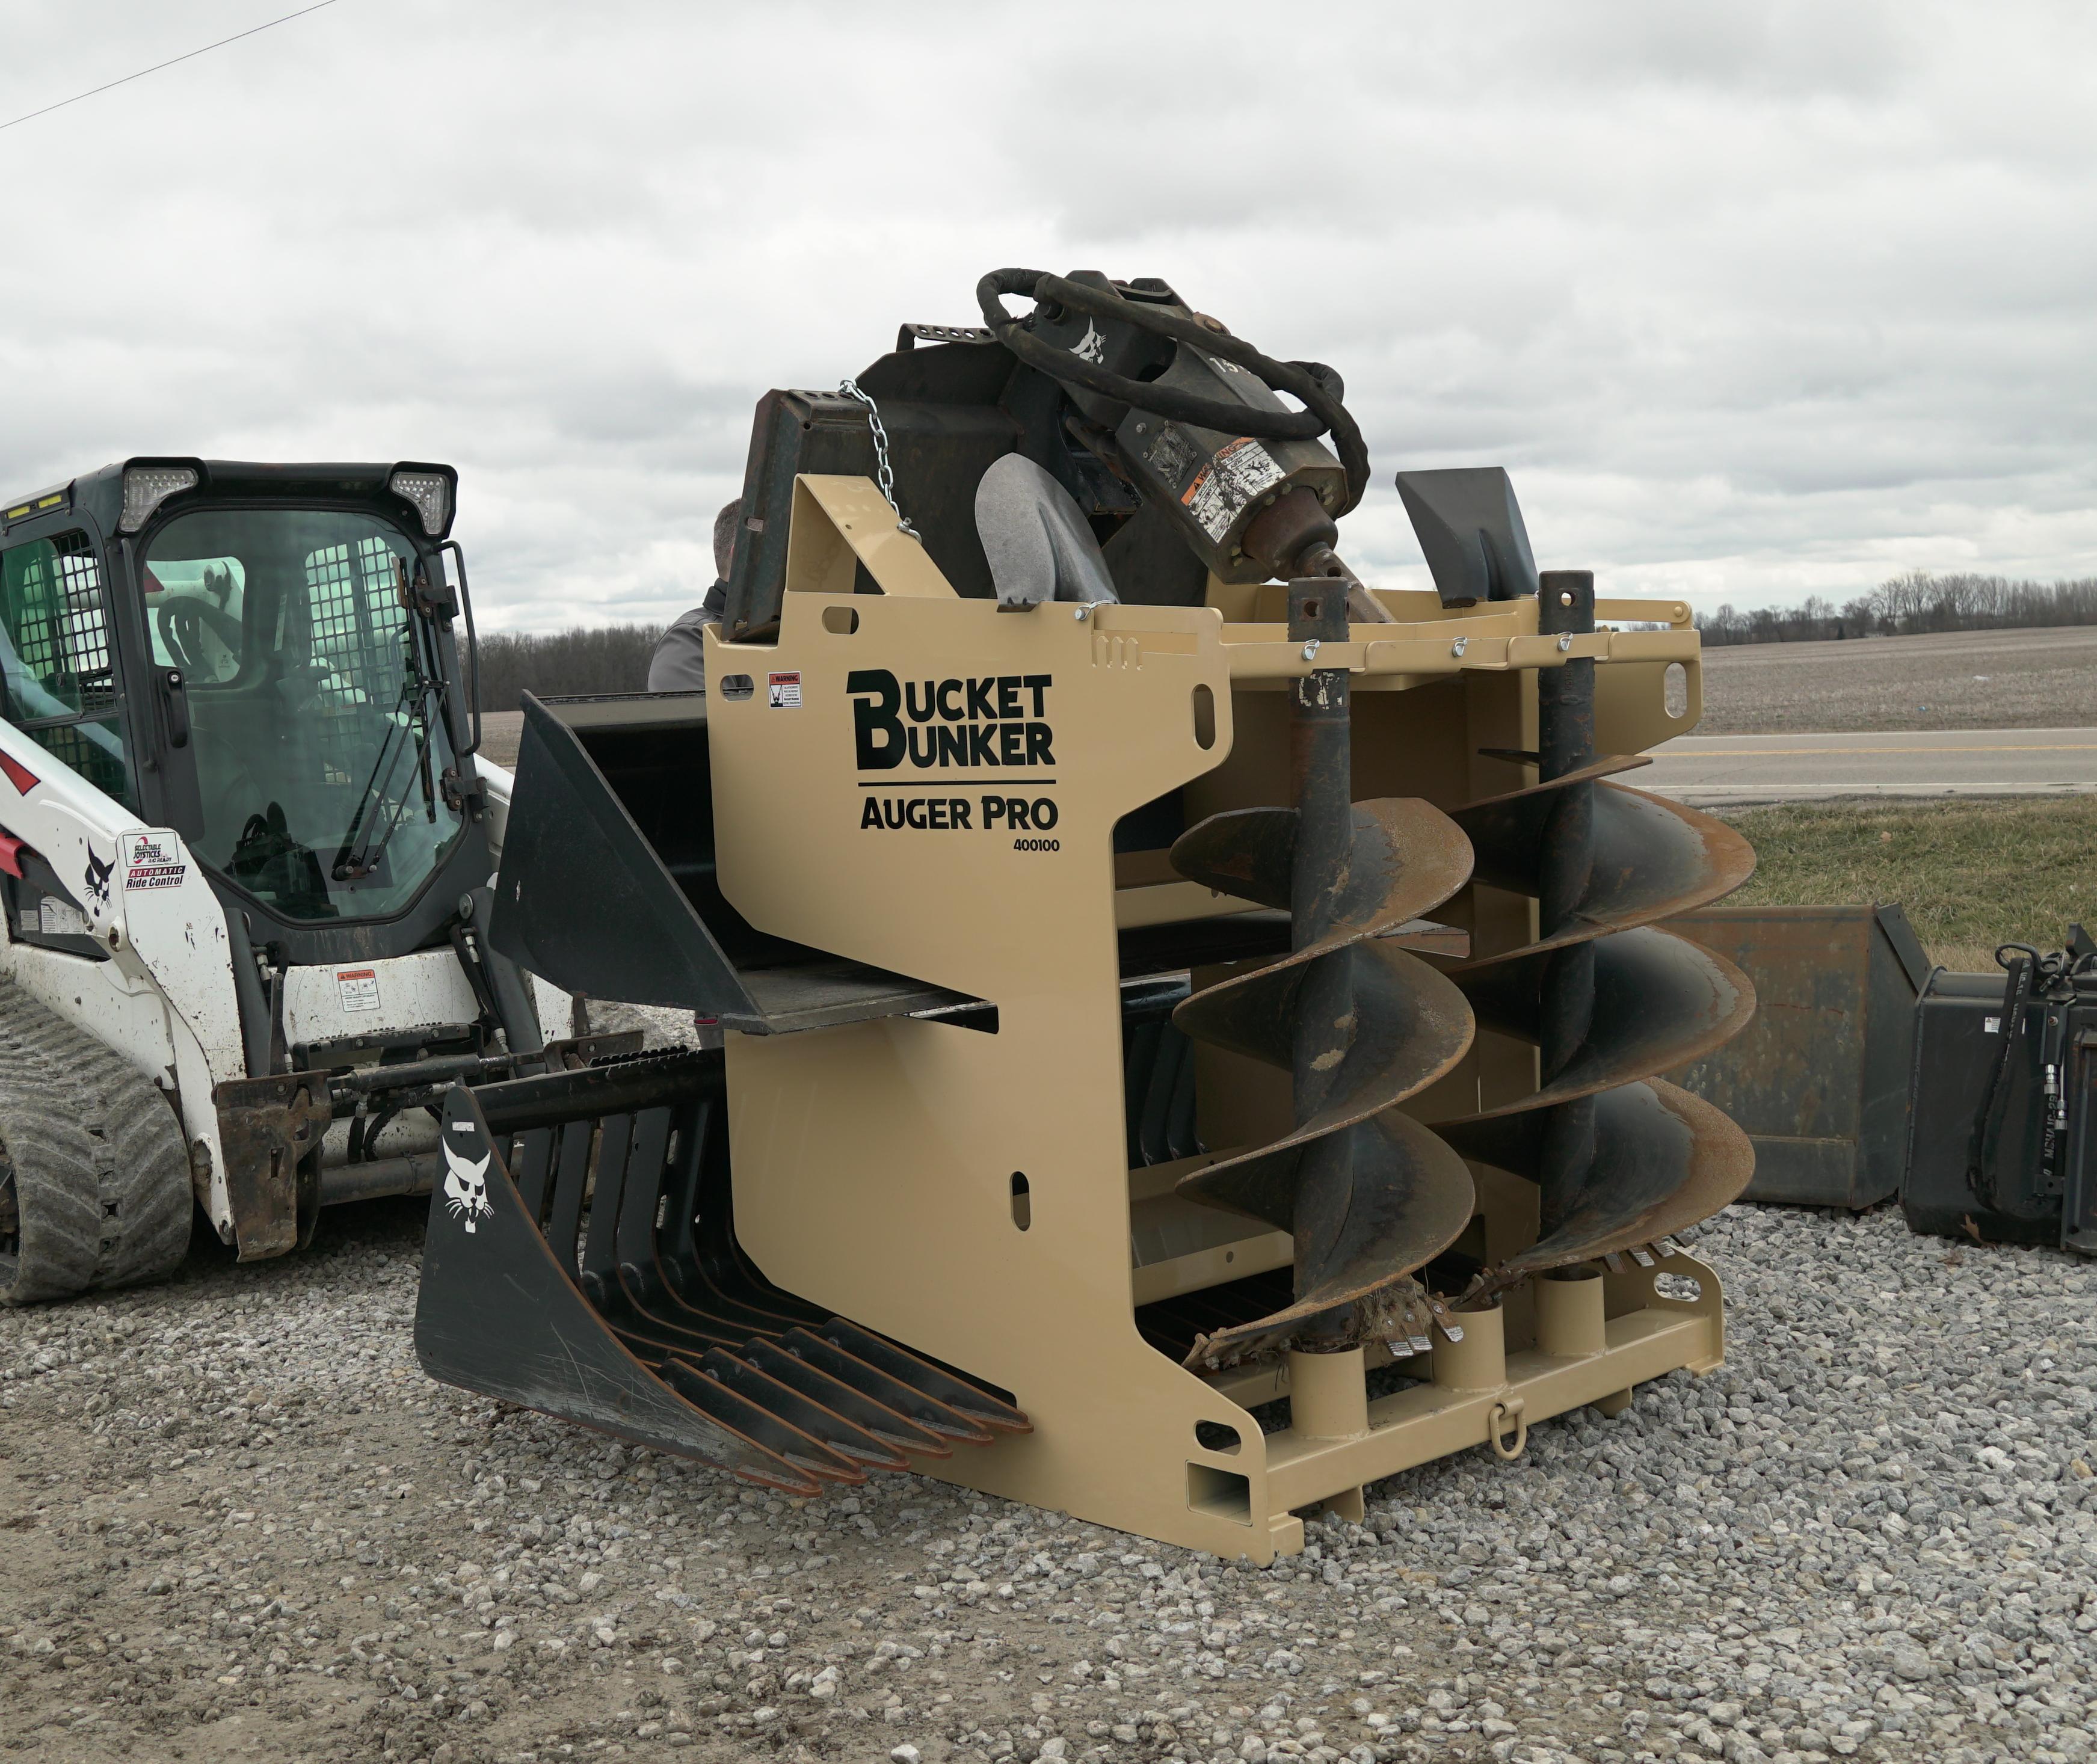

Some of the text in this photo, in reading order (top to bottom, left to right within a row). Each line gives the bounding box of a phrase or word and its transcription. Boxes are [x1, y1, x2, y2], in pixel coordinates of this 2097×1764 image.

[846, 669, 1052, 723] BUCKET
[854, 722, 1056, 770] BUNKER
[861, 796, 1058, 831] AUGER PRO
[1014, 839, 1060, 851] 400100
[134, 850, 161, 859] JOYSTICKS
[131, 867, 183, 877] AUTOMATIC
[126, 875, 183, 888] Ride Control
